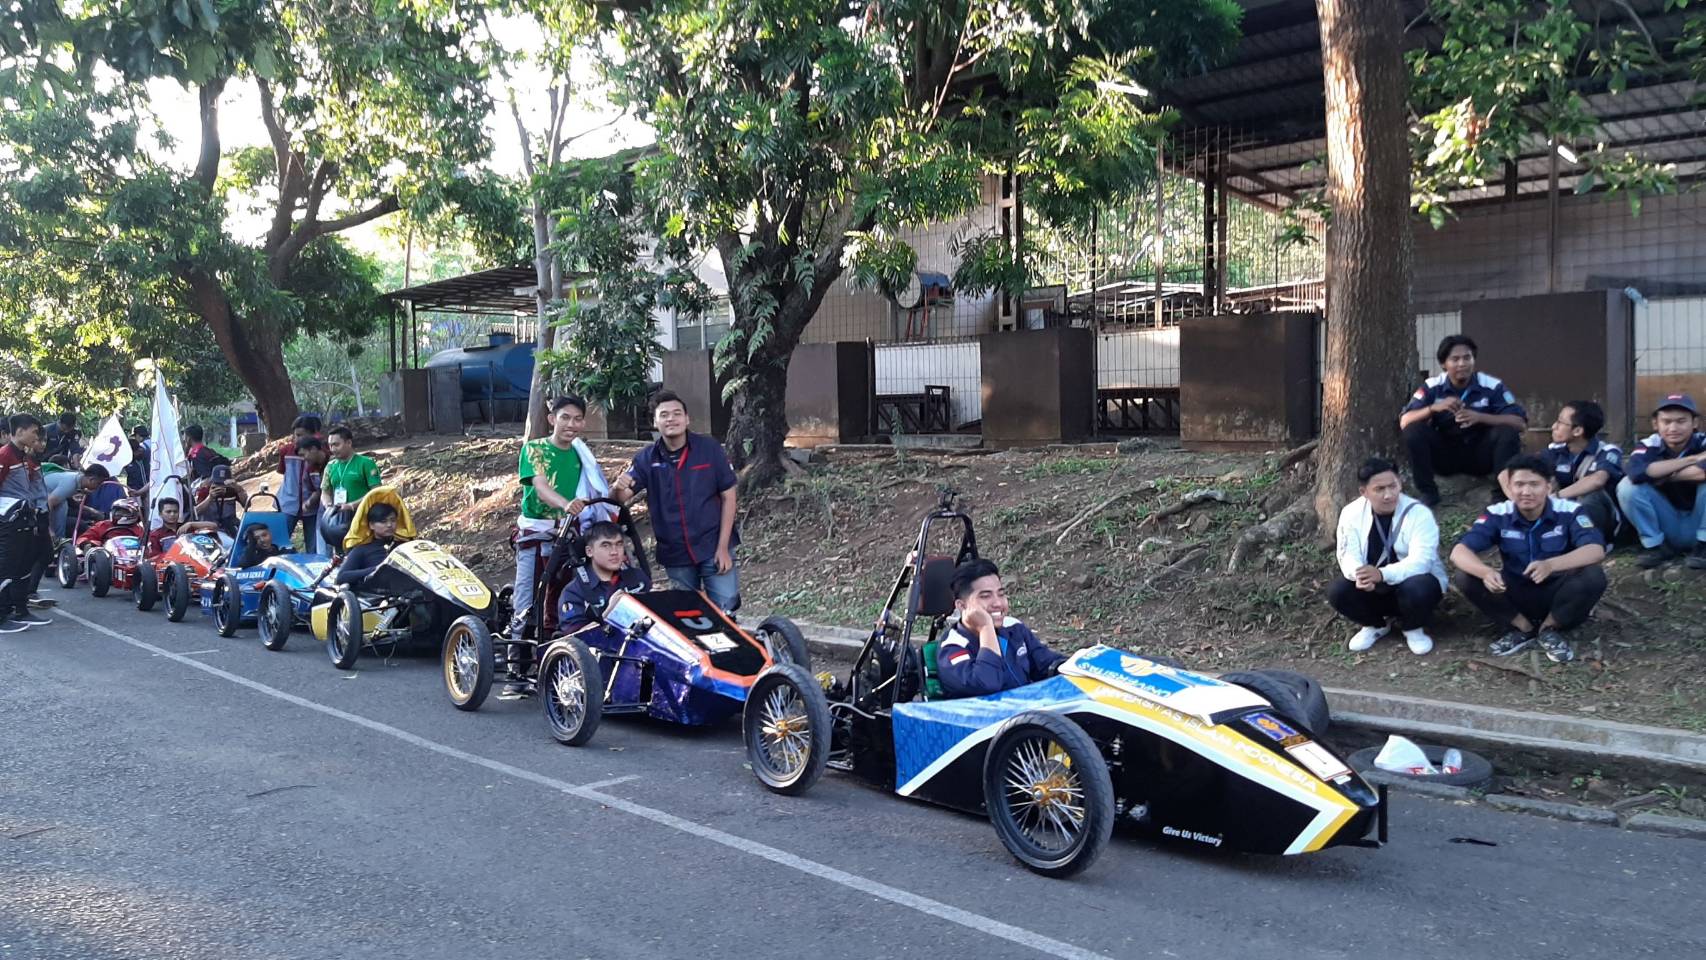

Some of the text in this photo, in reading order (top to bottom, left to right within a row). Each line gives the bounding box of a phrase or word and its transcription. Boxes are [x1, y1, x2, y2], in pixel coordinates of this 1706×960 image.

[1233, 741, 1317, 792] INDONESIA
[1162, 826, 1222, 847] Give Us Victory
